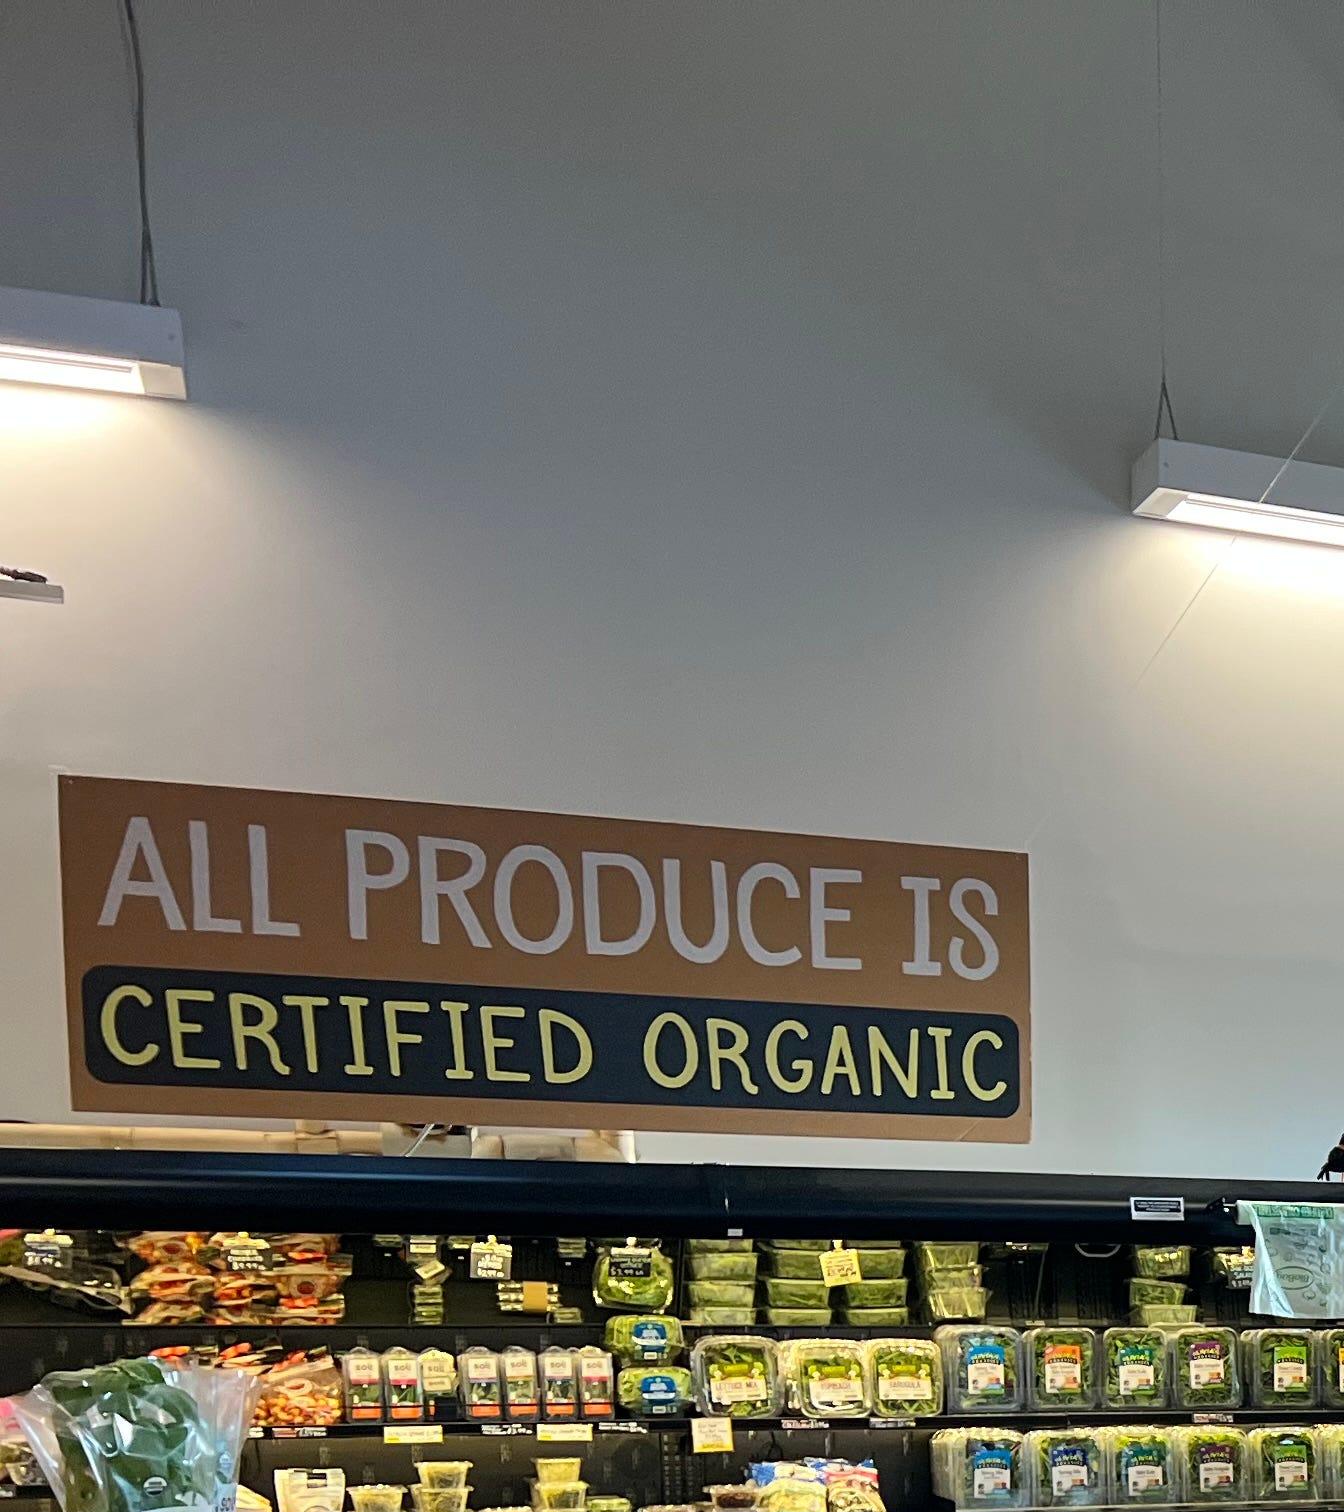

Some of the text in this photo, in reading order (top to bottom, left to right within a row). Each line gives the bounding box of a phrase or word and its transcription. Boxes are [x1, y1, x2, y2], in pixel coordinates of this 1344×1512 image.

[97, 816, 1000, 981] ALL PRODUCE IS
[99, 984, 1009, 1103] CERTIFIED ORGANIC
